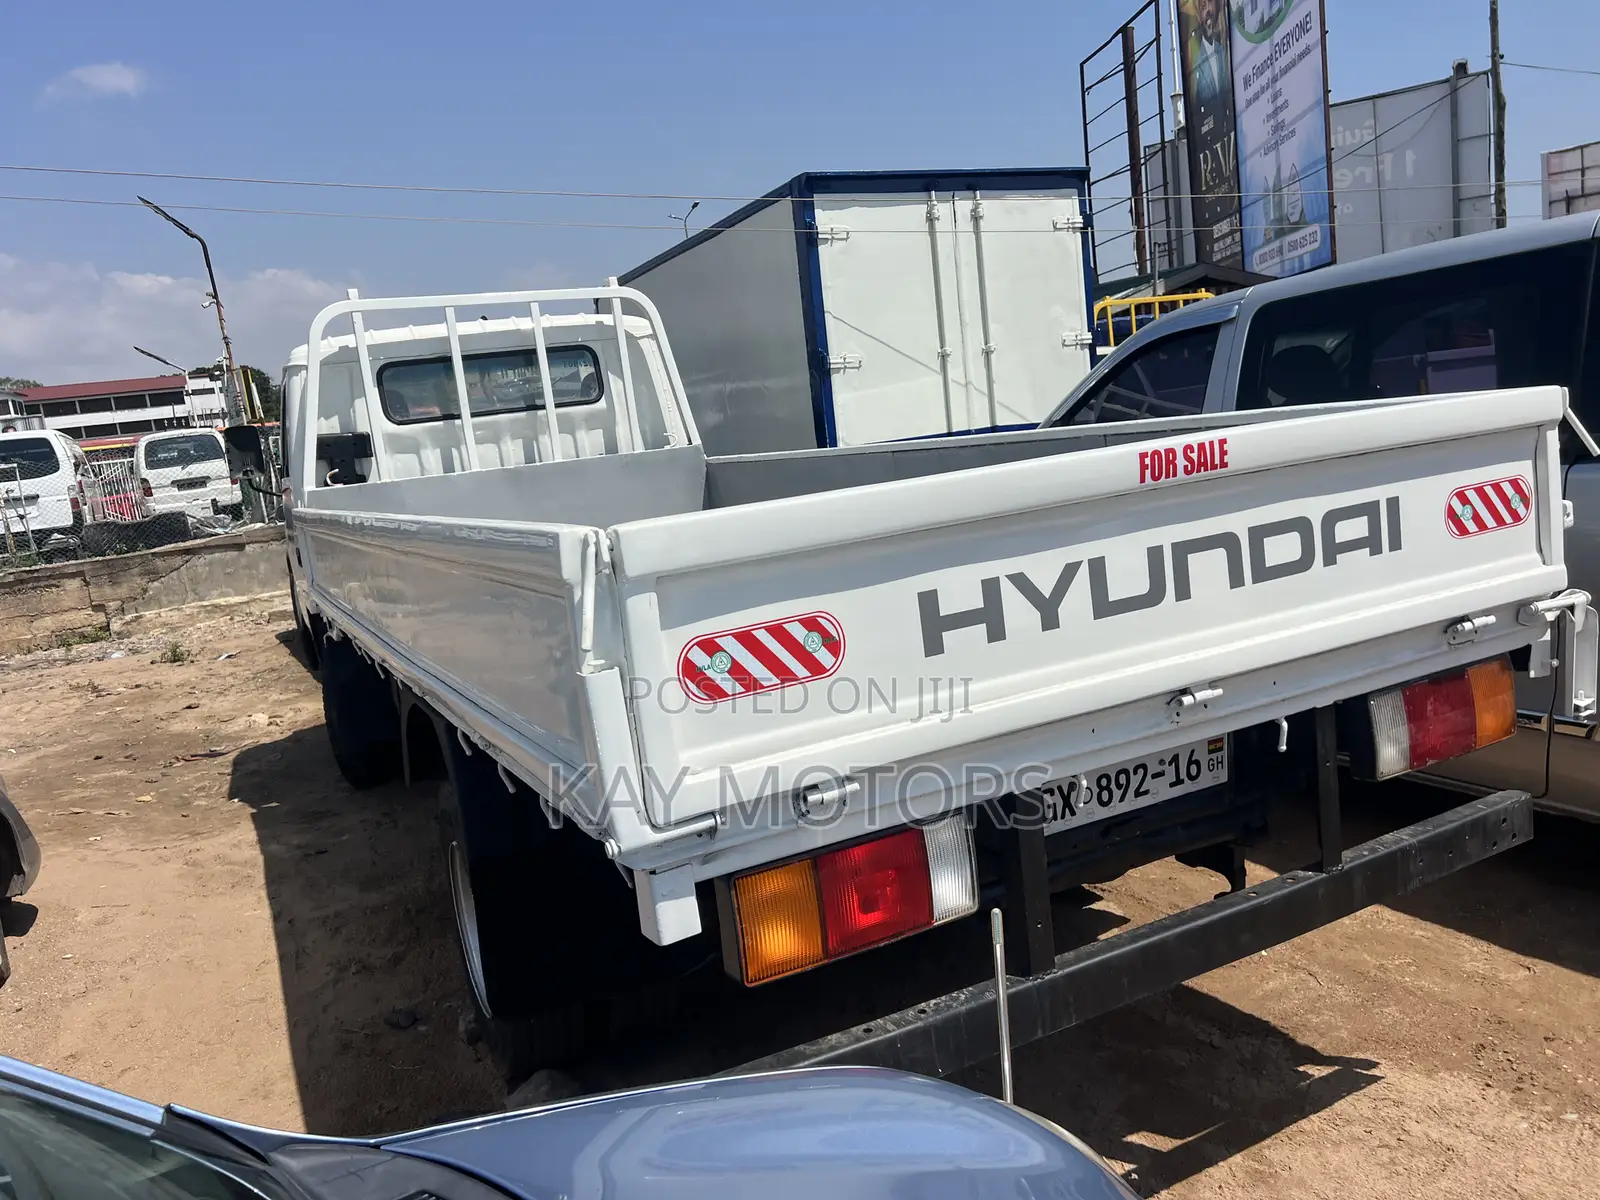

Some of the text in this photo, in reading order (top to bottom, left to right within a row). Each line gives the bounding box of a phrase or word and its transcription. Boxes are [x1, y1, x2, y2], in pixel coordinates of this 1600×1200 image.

[1242, 11, 1313, 91] We Finance EVERYONE!
[1138, 438, 1229, 484] FOR SALE
[917, 495, 1403, 658] HYUNDAI
[1096, 748, 1201, 808] 892-16
[1207, 754, 1224, 772] GH
